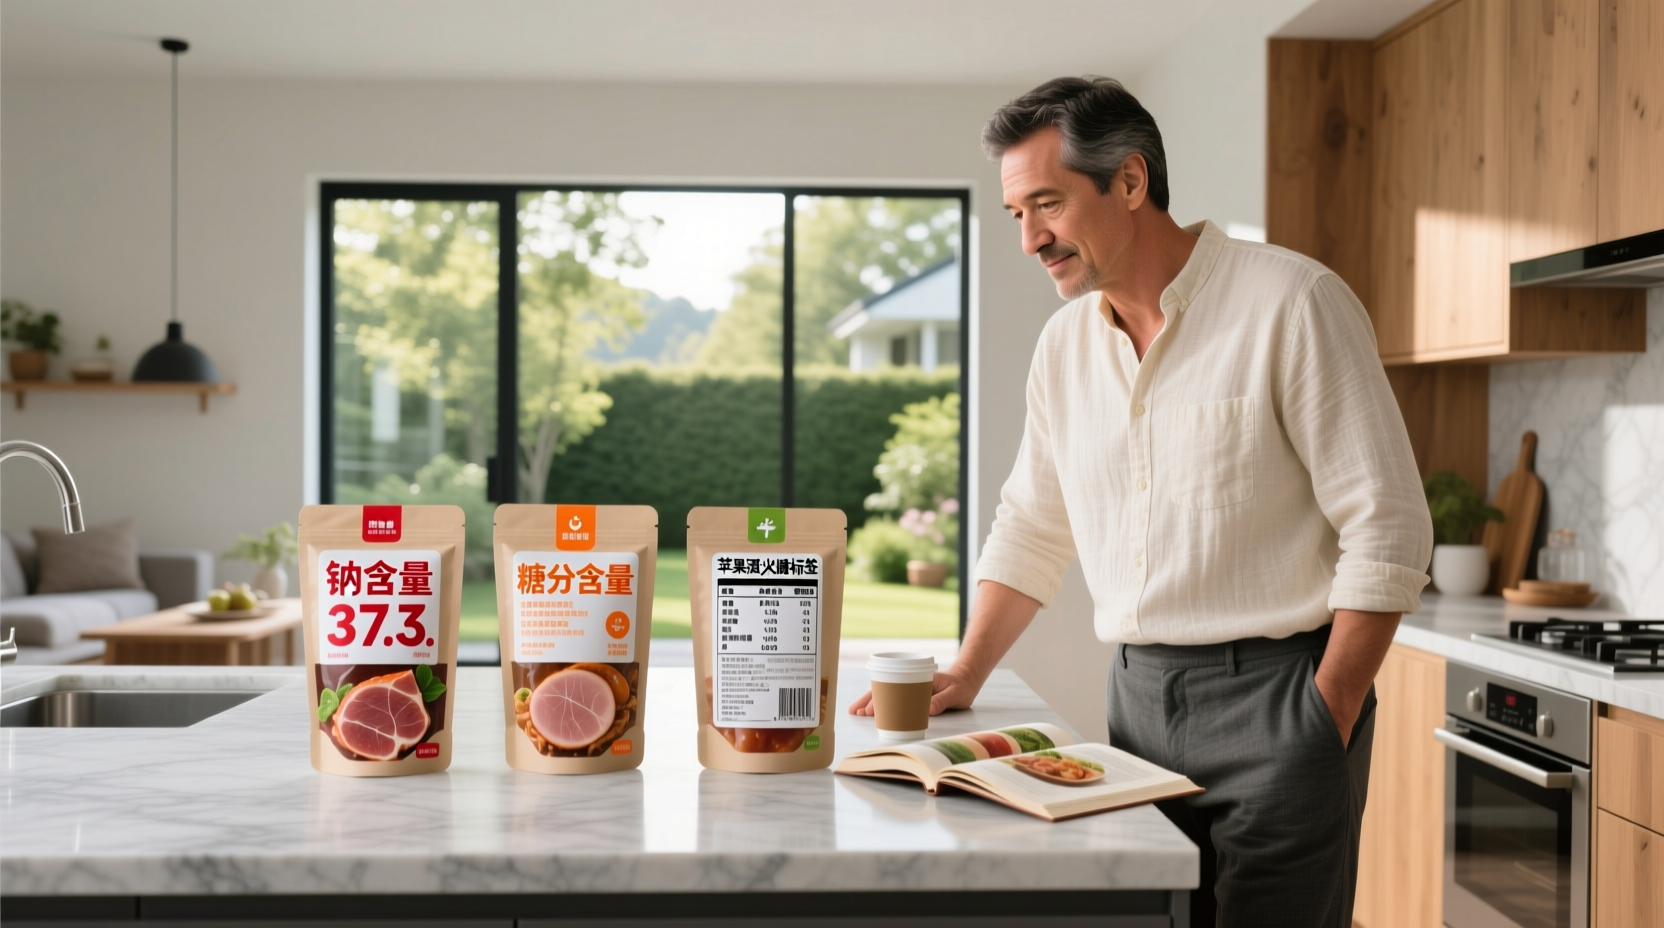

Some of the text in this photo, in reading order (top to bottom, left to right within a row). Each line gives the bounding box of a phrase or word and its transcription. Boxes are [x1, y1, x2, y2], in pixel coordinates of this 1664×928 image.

[326, 560, 433, 596] 钠含量
[517, 562, 634, 595] 糖分含量
